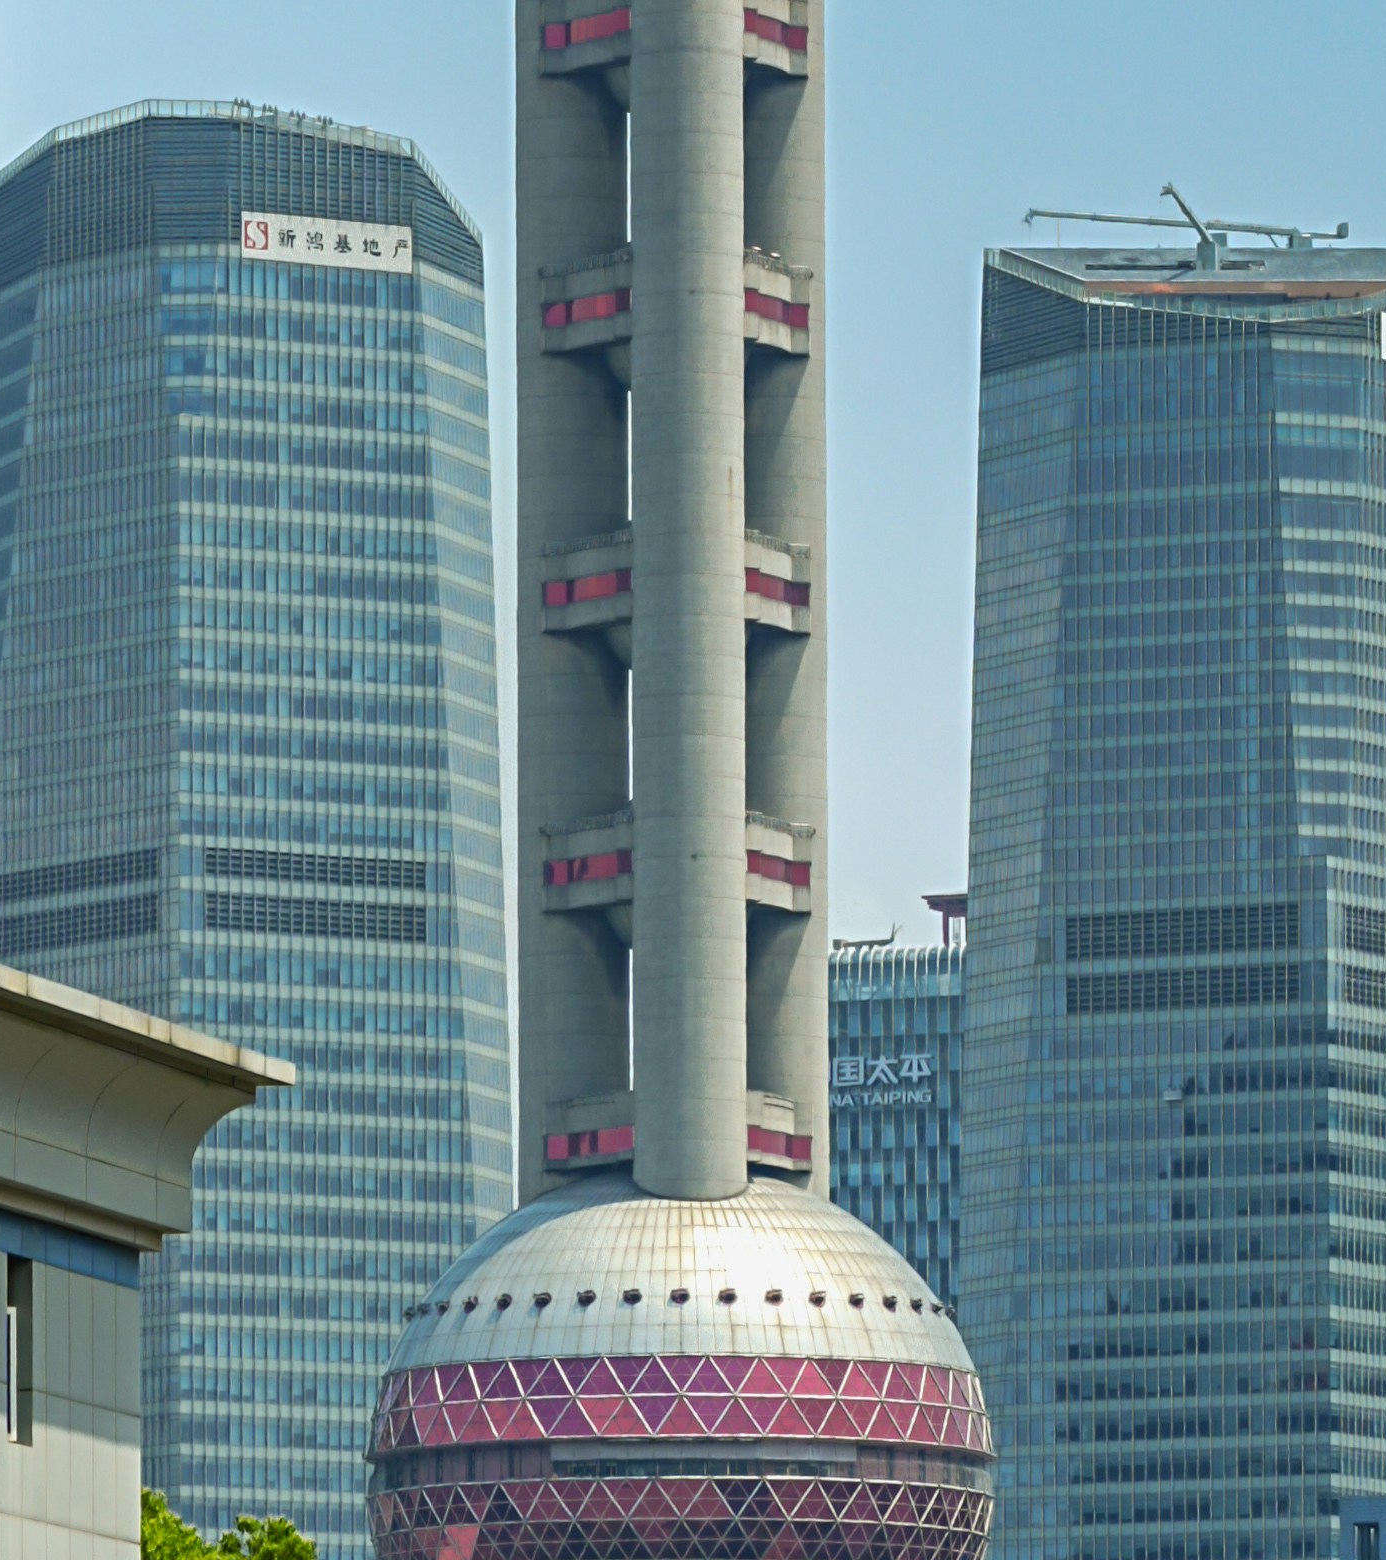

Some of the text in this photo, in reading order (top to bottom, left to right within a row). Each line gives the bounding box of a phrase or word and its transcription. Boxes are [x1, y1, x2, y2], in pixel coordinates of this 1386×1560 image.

[278, 229, 409, 259] 新鸿基地产
[829, 1054, 932, 1087] 国太平
[861, 1089, 932, 1105] TAIPING
